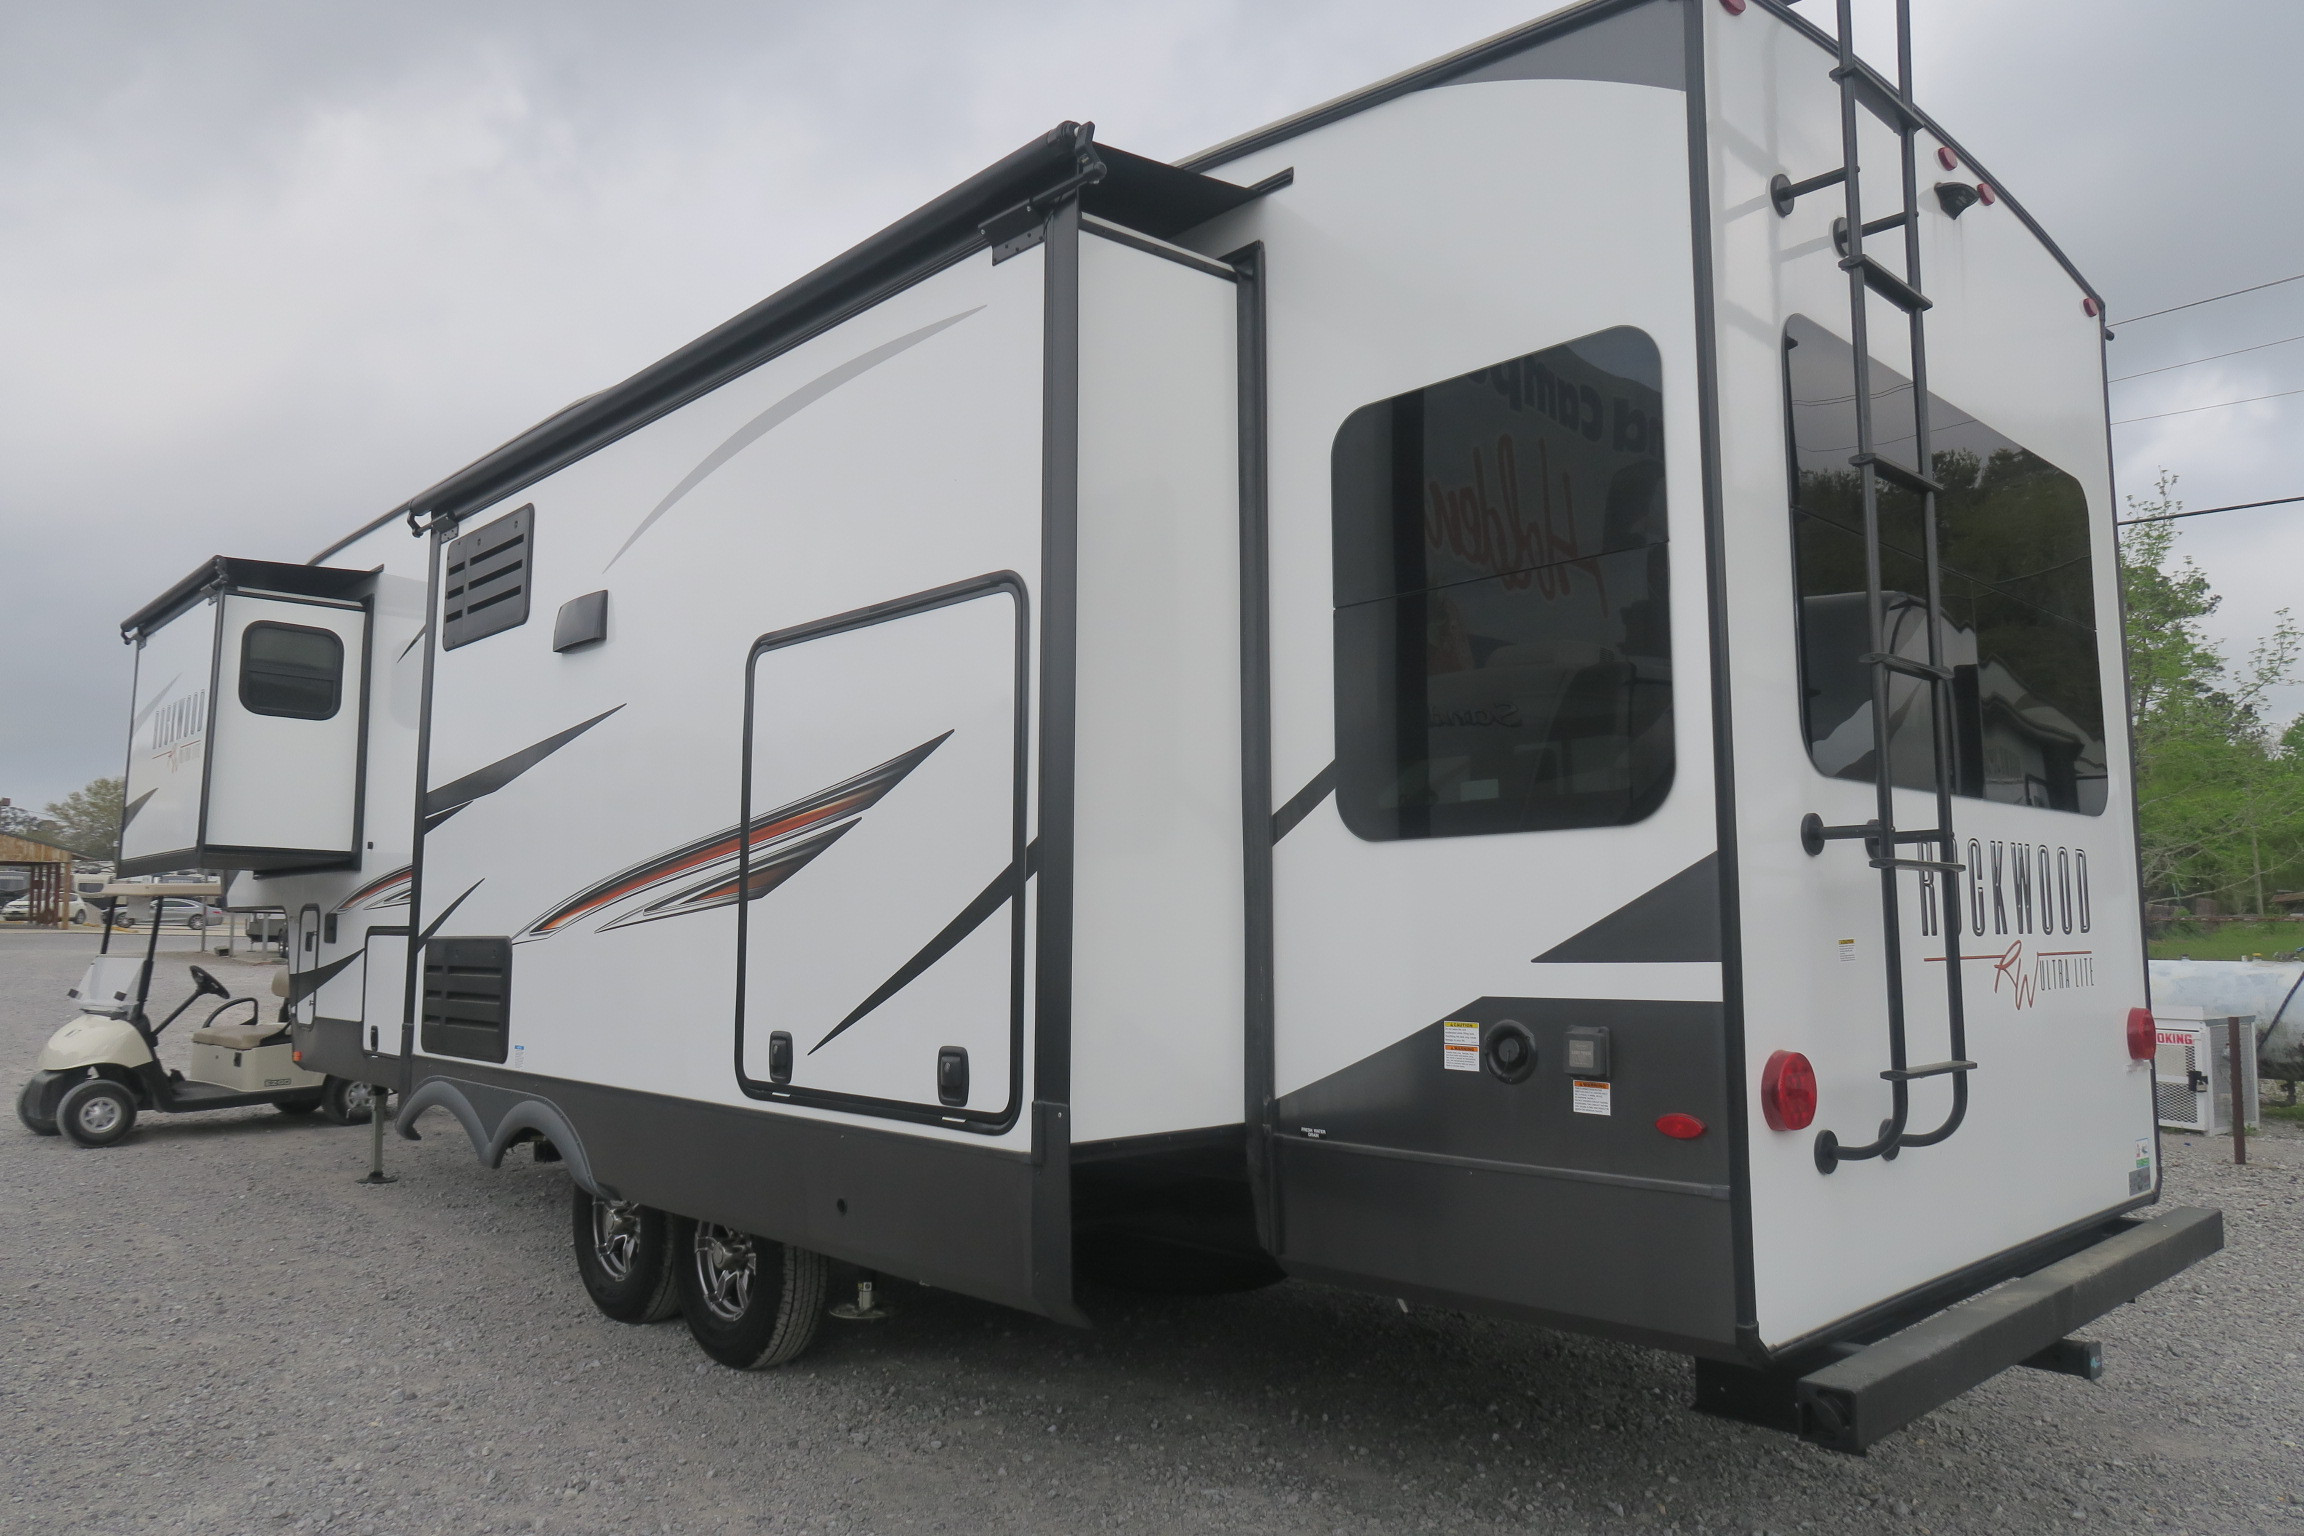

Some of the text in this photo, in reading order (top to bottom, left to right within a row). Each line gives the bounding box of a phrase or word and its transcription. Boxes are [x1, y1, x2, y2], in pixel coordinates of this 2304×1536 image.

[1917, 837, 2091, 936] RCKWOOD
[2040, 959, 2070, 990] ULTRA
[2075, 958, 2094, 987] LITE
[2156, 1032, 2194, 1045] OKING
